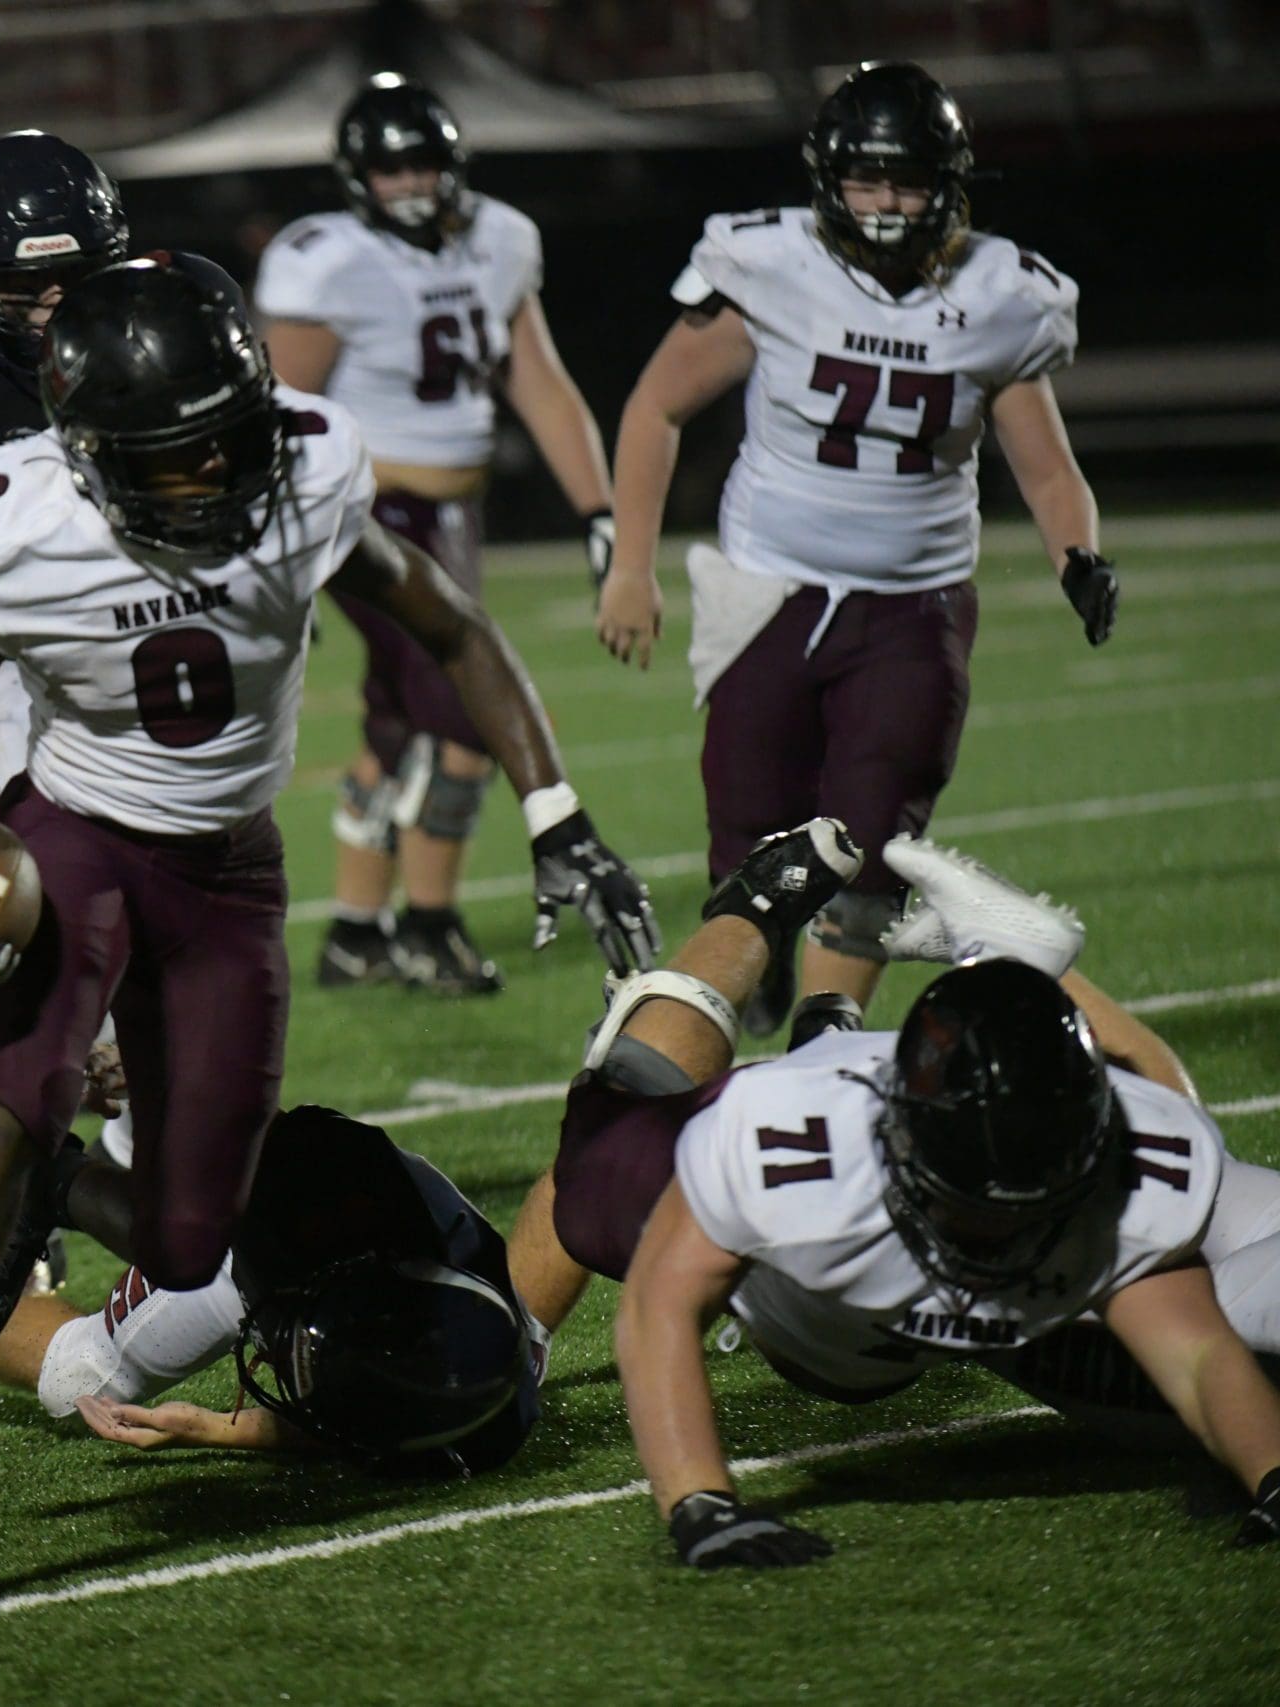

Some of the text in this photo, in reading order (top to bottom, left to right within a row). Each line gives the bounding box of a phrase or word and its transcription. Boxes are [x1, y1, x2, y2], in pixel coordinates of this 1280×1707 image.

[843, 329, 927, 364] NAVARRE
[810, 353, 956, 475] 77
[131, 628, 236, 748] 0
[756, 1116, 834, 1190] 71
[1120, 1131, 1191, 1194] 71
